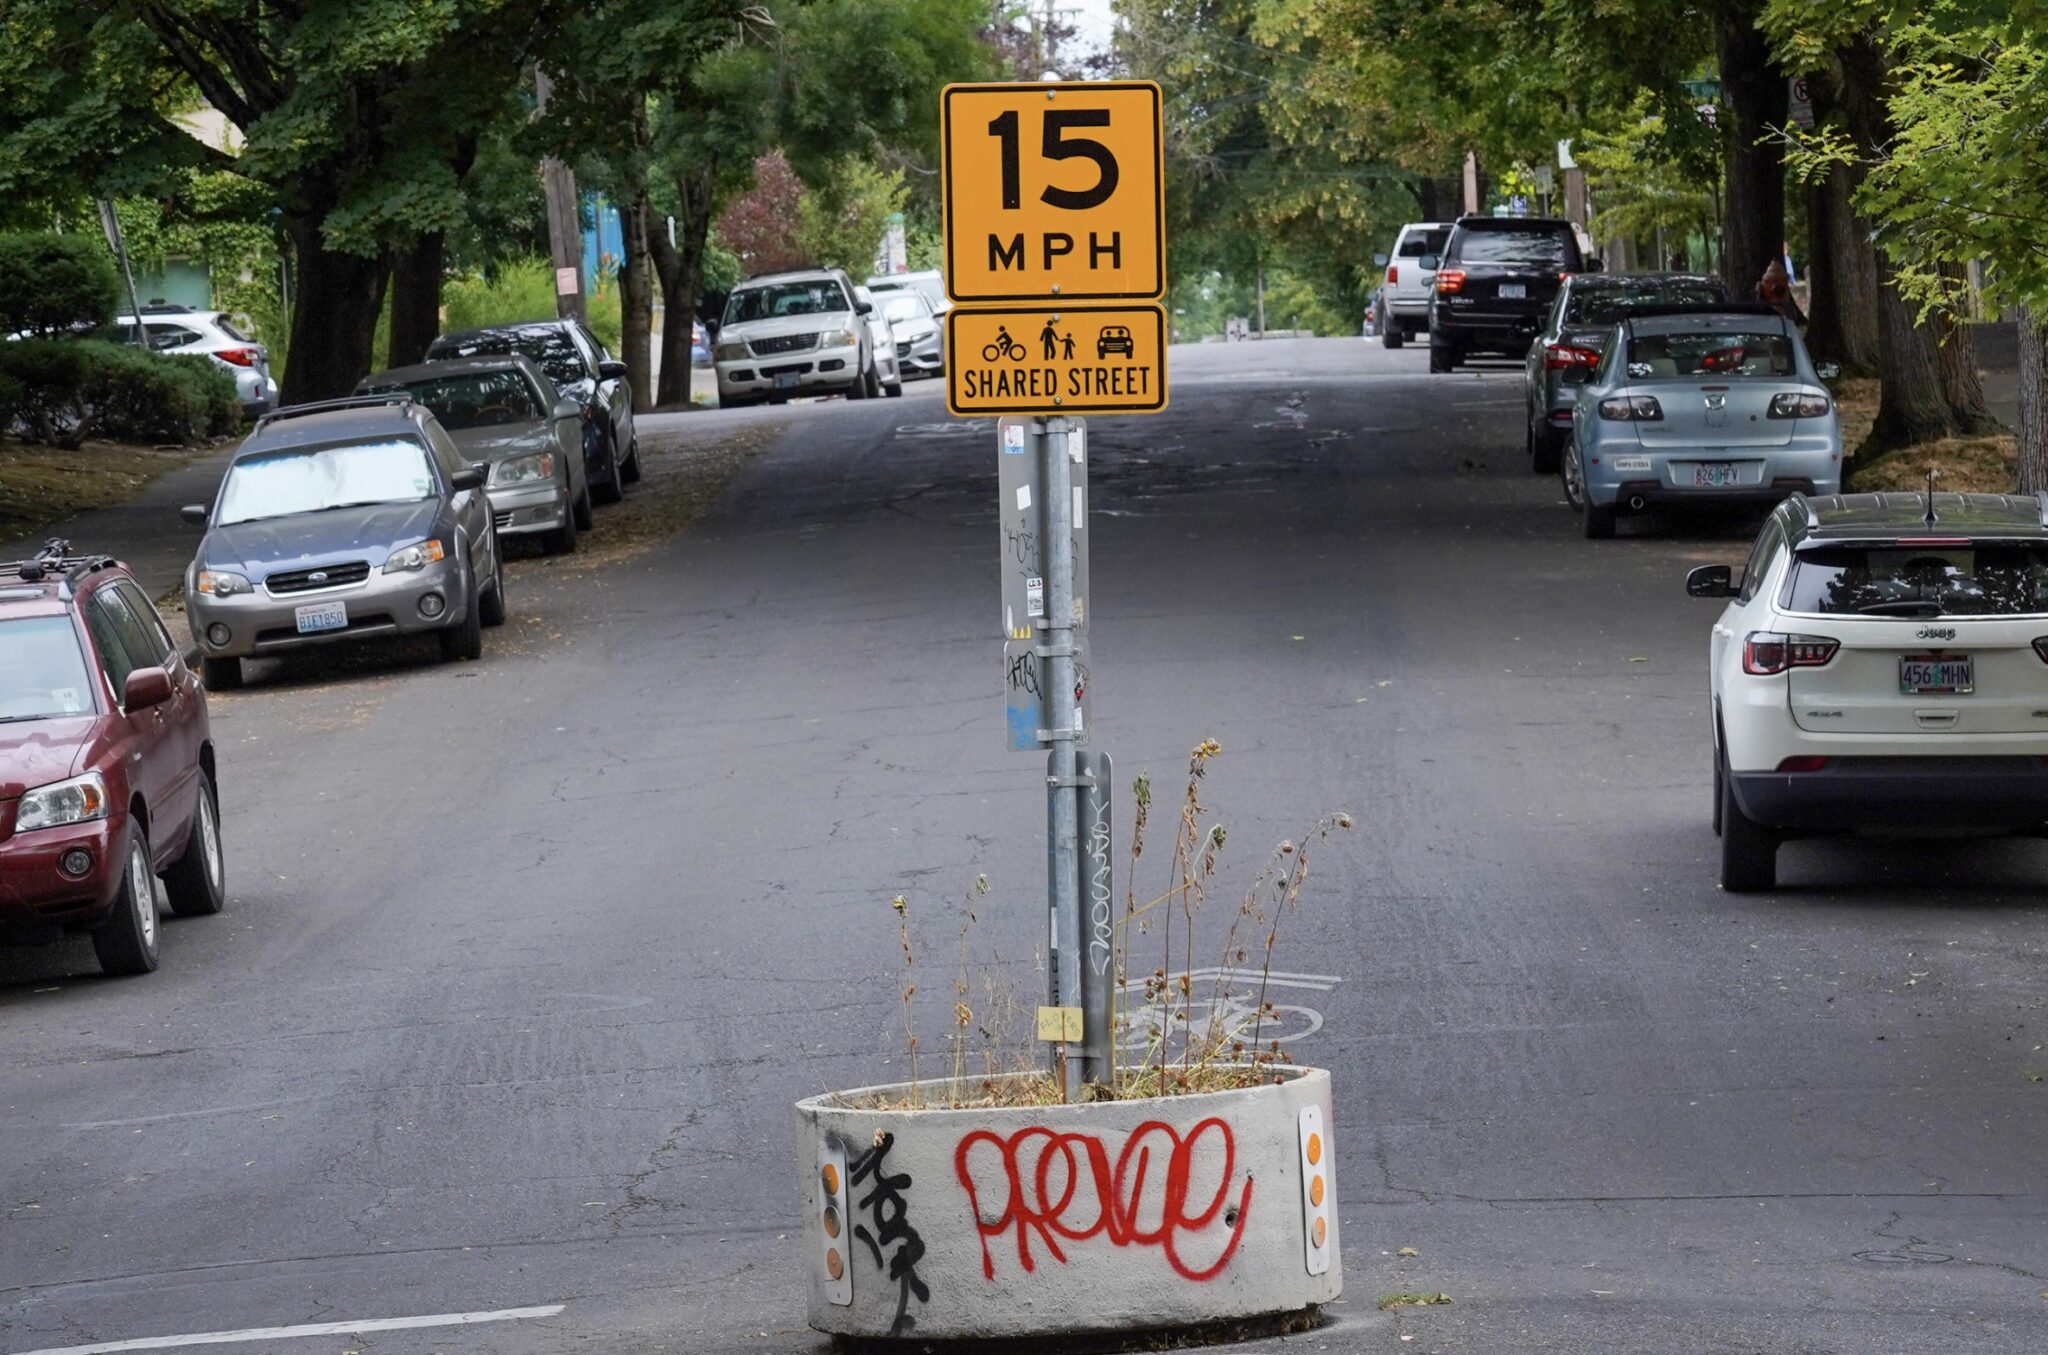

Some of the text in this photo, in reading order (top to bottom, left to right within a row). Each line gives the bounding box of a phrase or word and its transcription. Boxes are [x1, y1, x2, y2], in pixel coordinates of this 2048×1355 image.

[988, 109, 1119, 210] 15
[988, 231, 1121, 271] MPH
[964, 367, 1150, 398] SHARED STREET
[1696, 468, 1714, 481] 826
[1916, 625, 1957, 641] Jeep
[1904, 664, 1970, 685] 456 MHN
